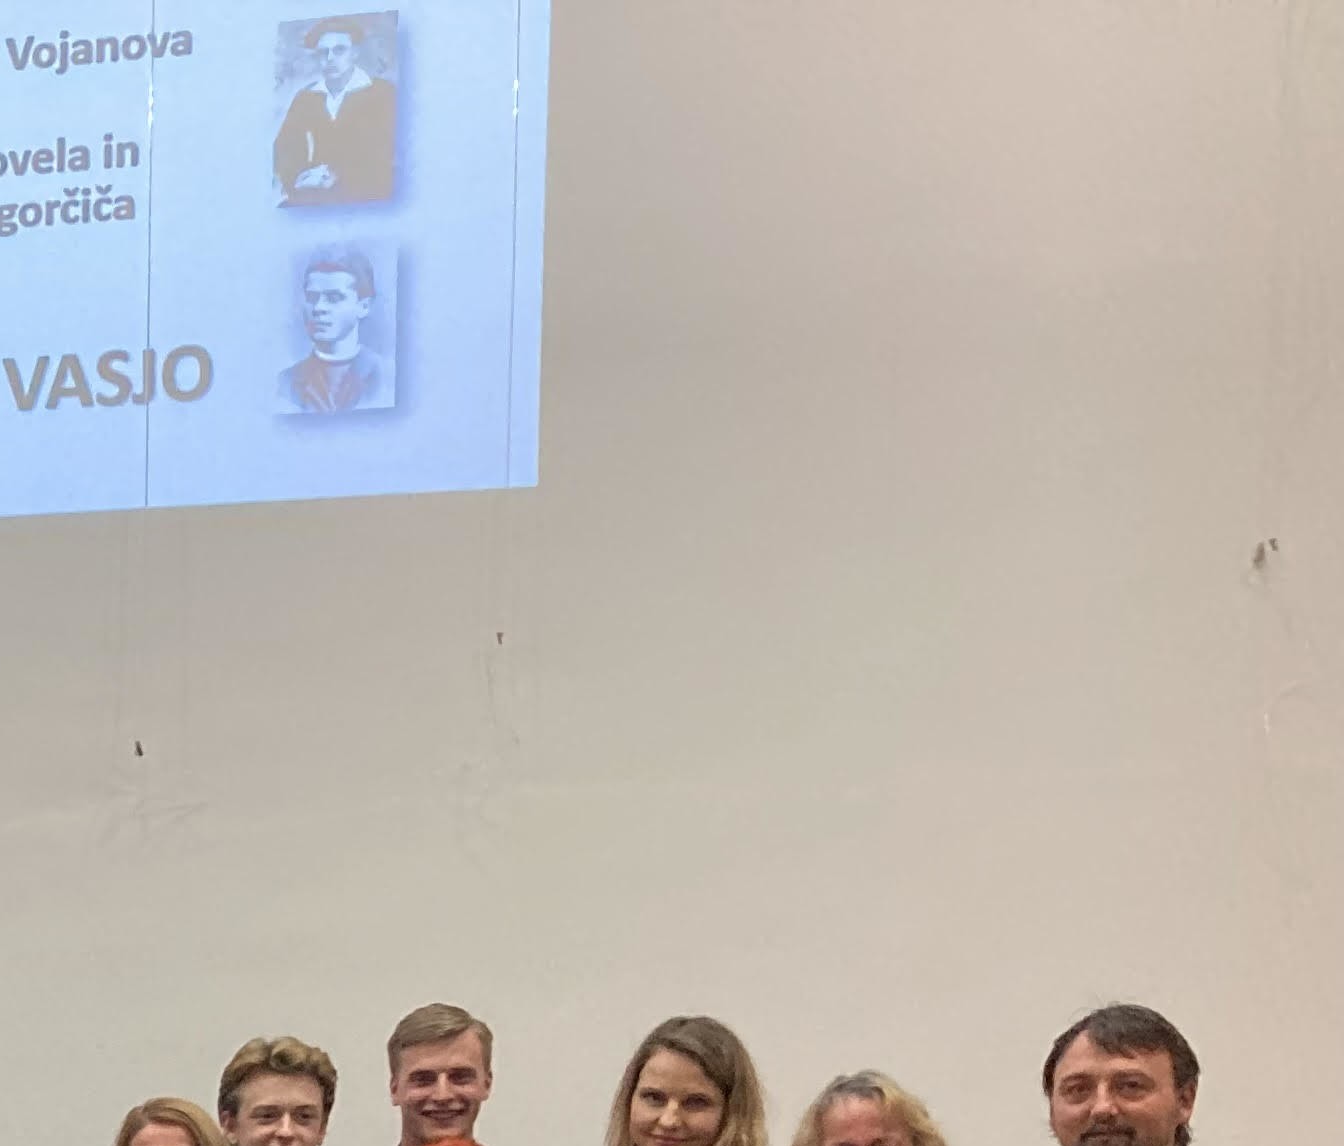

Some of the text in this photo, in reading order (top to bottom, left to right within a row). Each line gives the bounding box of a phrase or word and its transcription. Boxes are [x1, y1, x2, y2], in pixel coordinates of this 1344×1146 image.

[6, 30, 193, 74] Vojanova
[104, 133, 140, 169] in
[3, 344, 214, 411] VASJO
